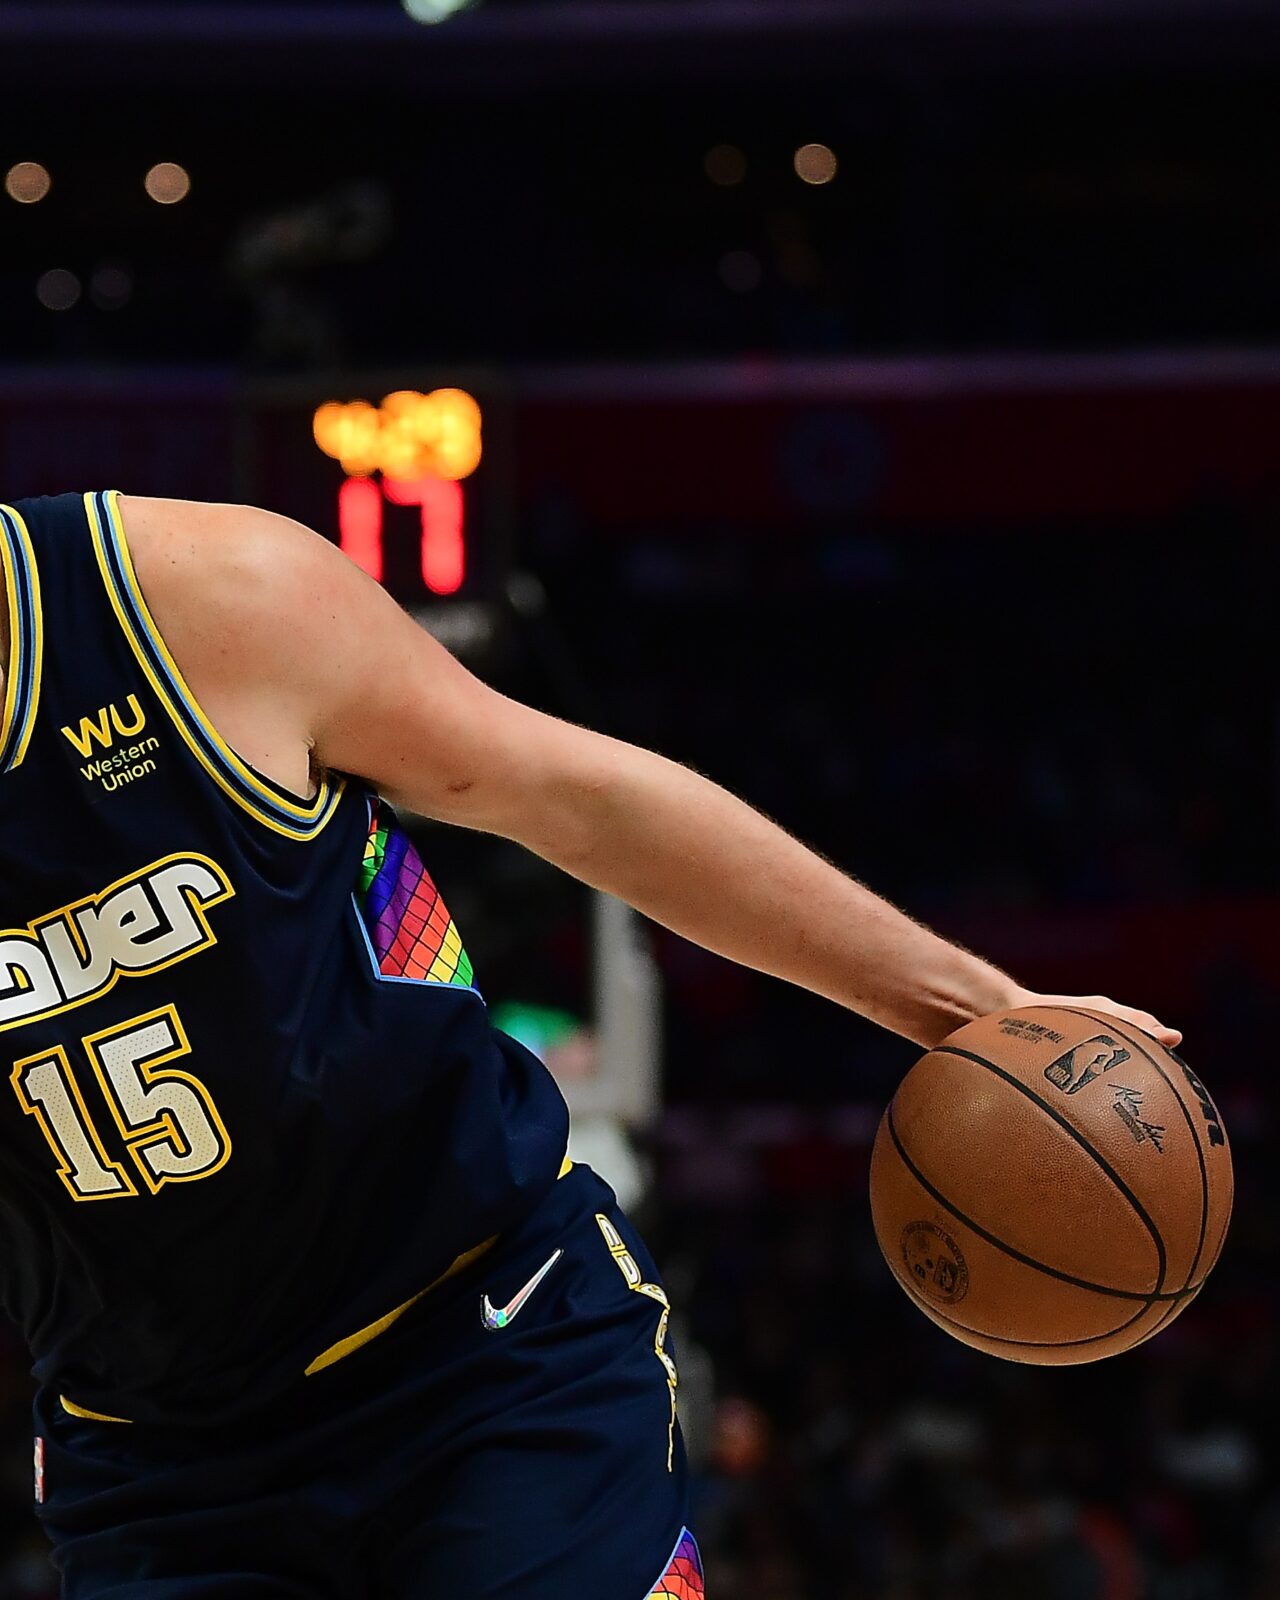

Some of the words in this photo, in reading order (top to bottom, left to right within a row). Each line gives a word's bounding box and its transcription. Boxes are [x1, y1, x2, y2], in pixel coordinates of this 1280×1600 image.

[60, 693, 146, 758] WU
[80, 737, 160, 781] Western
[101, 759, 157, 791] Union
[10, 1003, 232, 1201] 15
